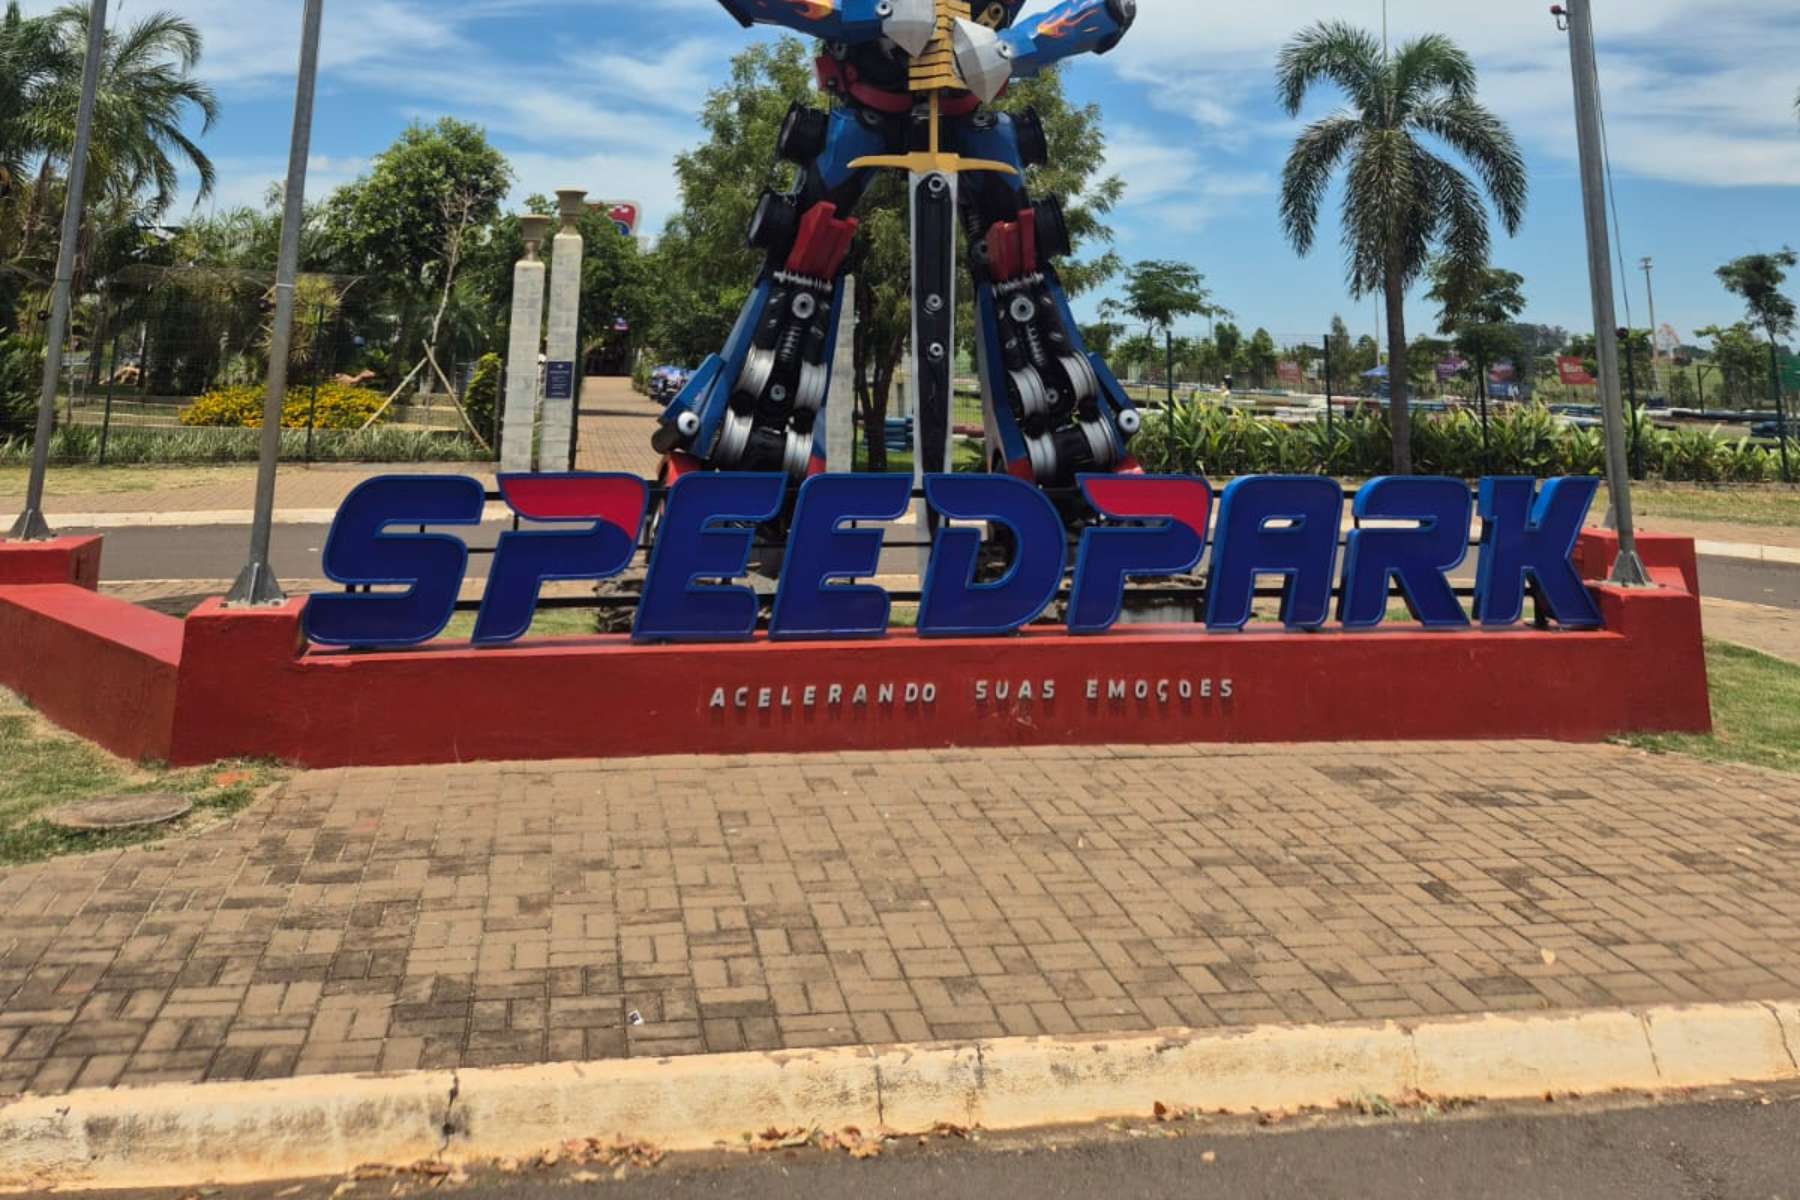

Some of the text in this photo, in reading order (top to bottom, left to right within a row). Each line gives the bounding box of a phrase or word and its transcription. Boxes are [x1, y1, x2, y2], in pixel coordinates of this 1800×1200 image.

[303, 471, 1606, 648] SPEEDPARK
[709, 681, 937, 708] ACELERANDO
[975, 679, 1056, 701] SUAS
